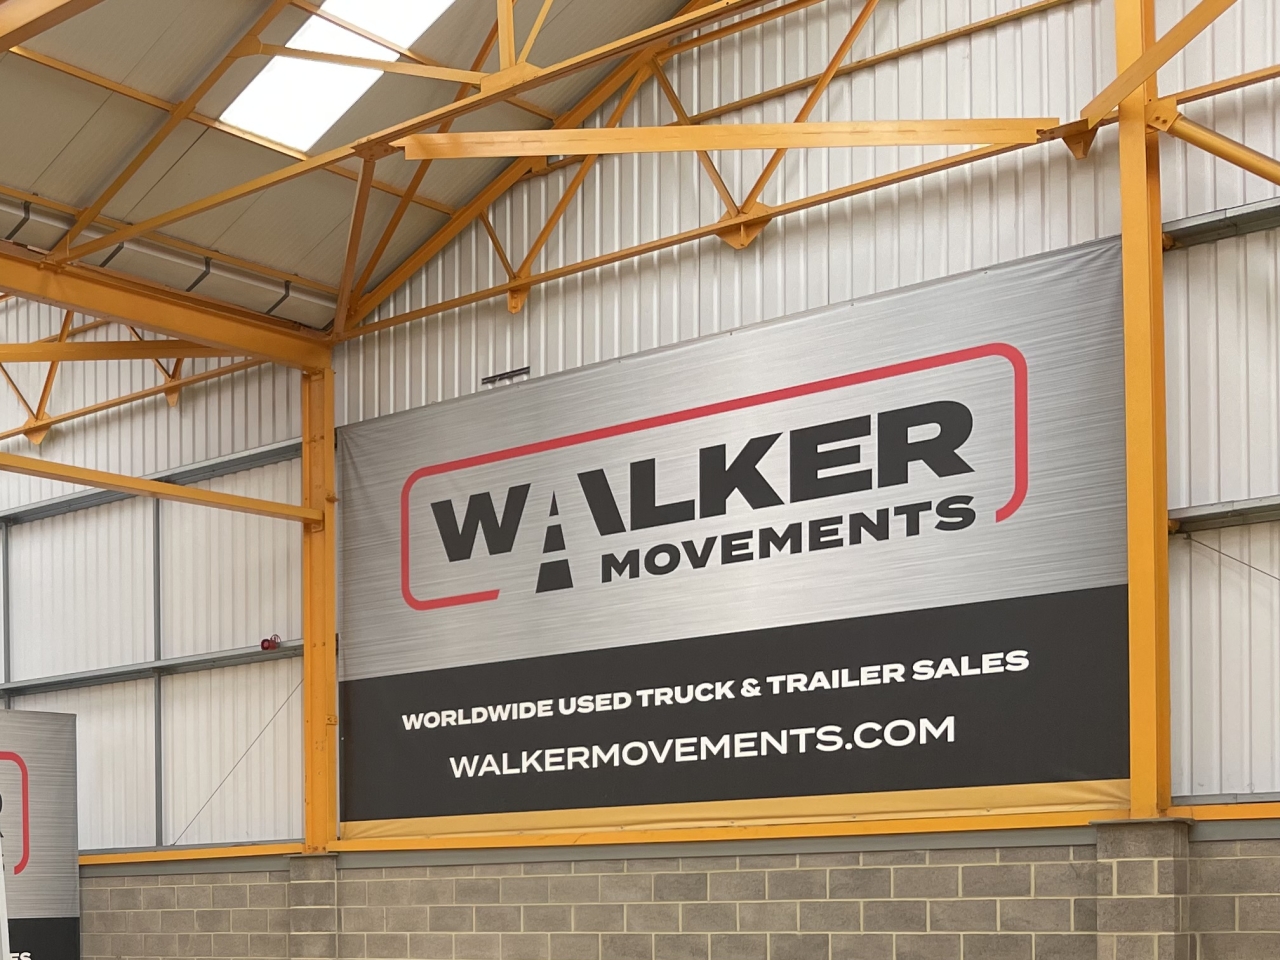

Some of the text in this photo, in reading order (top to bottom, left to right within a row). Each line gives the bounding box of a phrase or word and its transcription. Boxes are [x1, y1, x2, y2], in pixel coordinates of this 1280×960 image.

[430, 400, 976, 593] WALKER
[601, 495, 976, 584] MOVEMENTS
[402, 650, 1030, 731] WORLDWIDE USED TRUCK & TRAILER SALES
[449, 715, 955, 778] WALKERMOVEMENTS.COM
